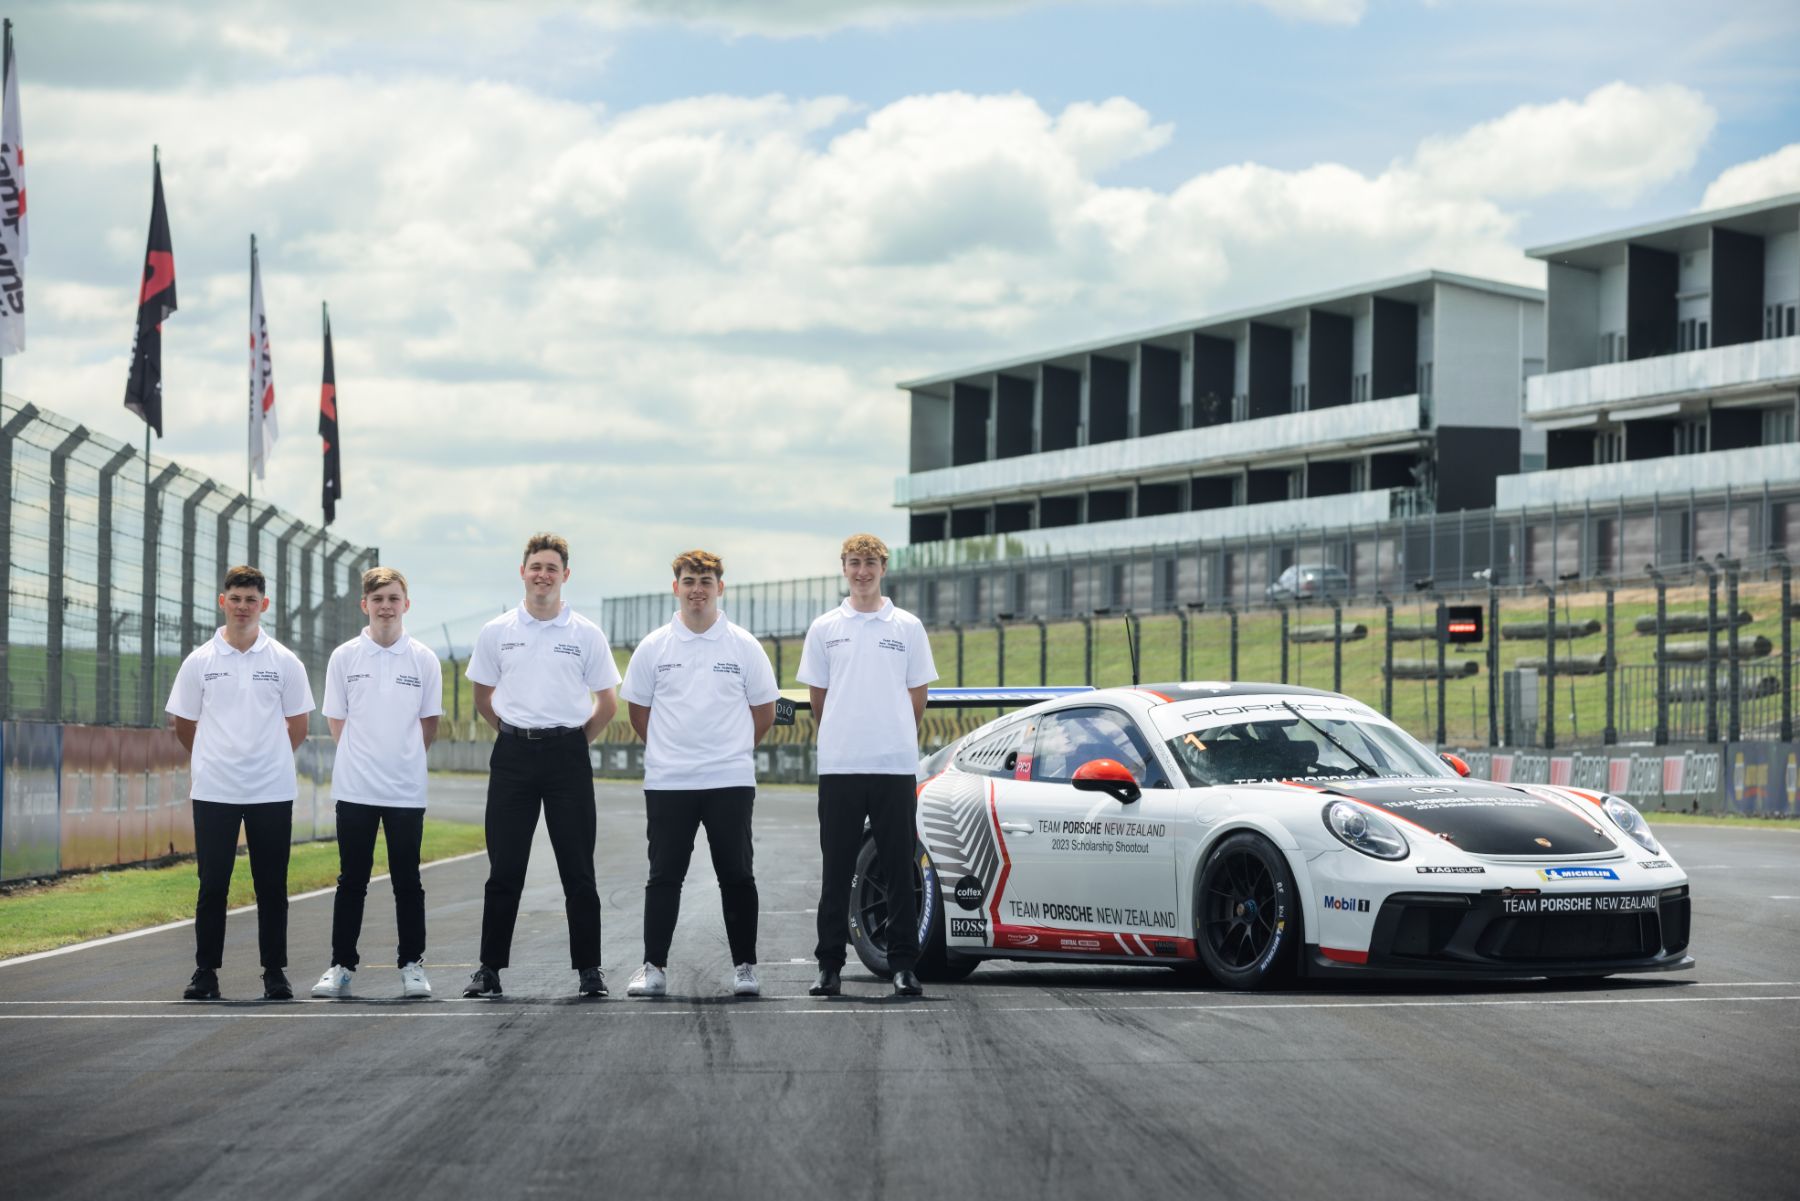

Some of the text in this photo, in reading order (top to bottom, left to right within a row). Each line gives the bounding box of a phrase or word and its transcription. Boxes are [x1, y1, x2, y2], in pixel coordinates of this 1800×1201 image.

[1628, 753, 1661, 804] Repco
[1682, 750, 1719, 800] Repco
[1038, 820, 1166, 837] TEAM PORSCHE NEW ZEALAND
[1052, 839, 1149, 854] 2023 Scholarship Shootout
[1561, 870, 1611, 878] MICHELIN
[957, 888, 982, 897] coffex
[1324, 895, 1356, 911] Mobil
[1503, 895, 1657, 913] TEAM PORSCHE NEW ZEALAND
[1009, 900, 1177, 928] TEAM PORSCHE NEW ZEALAND
[952, 920, 985, 932] BOSS
